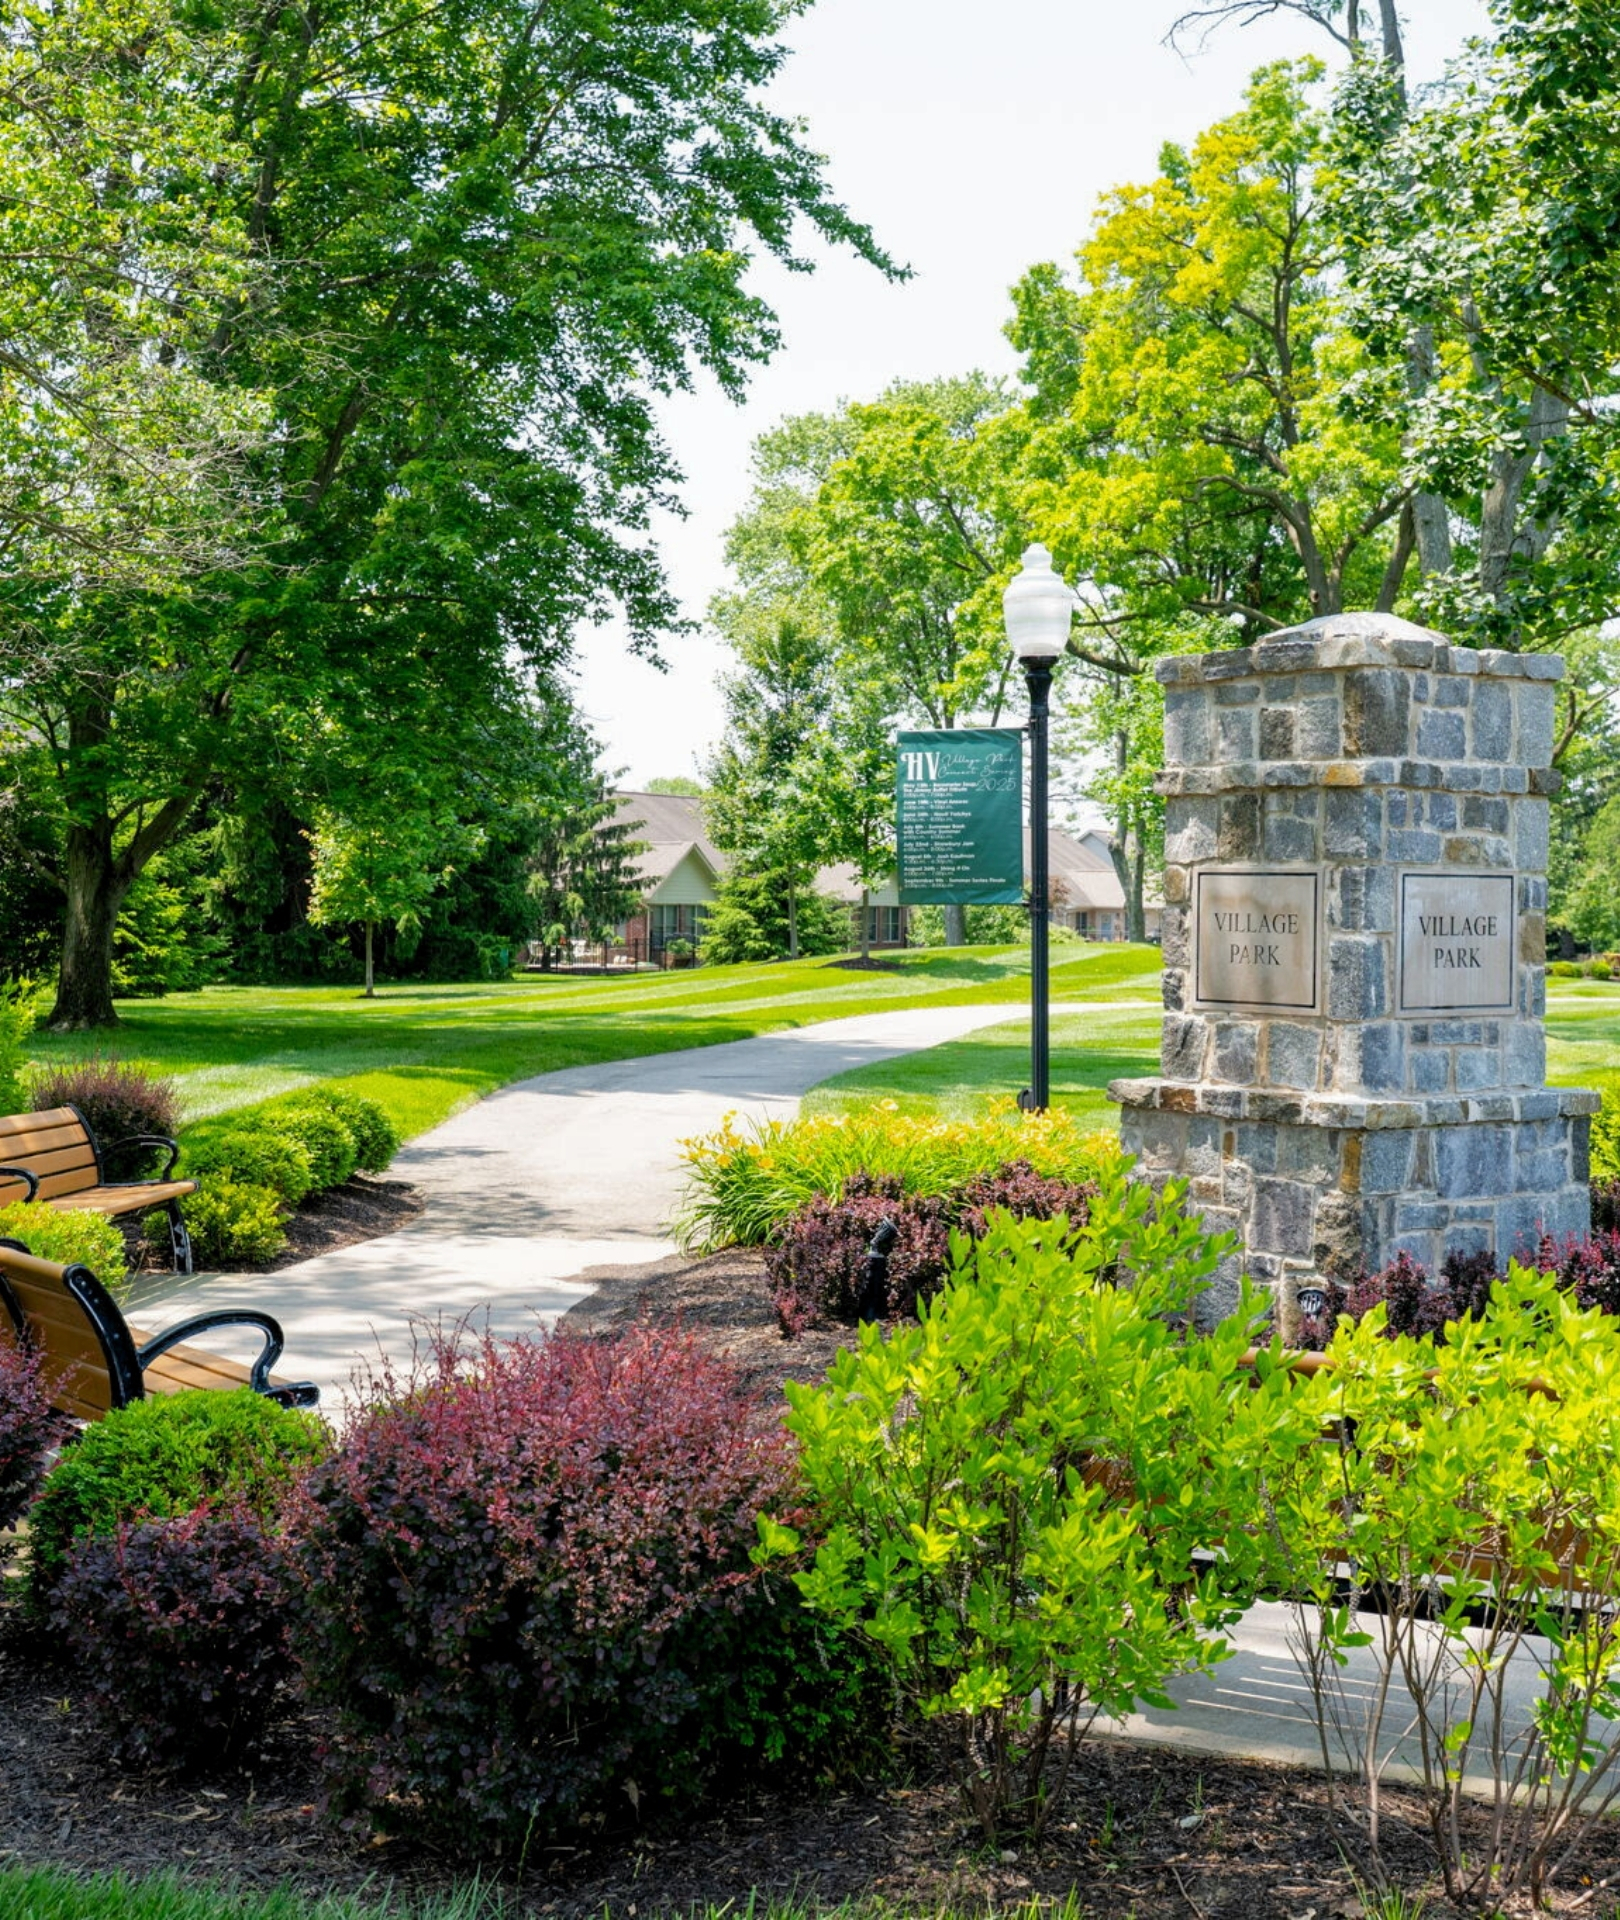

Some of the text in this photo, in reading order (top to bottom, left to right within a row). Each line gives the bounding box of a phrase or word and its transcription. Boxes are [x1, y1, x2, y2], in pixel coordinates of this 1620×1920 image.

[900, 752, 941, 781] HV
[941, 753, 981, 769] Village
[975, 777, 1017, 792] 2025
[1214, 912, 1299, 934] VILLAGE
[1419, 916, 1498, 936] VILLAGE
[1230, 943, 1281, 966] PARK
[1434, 947, 1482, 968] PARK
